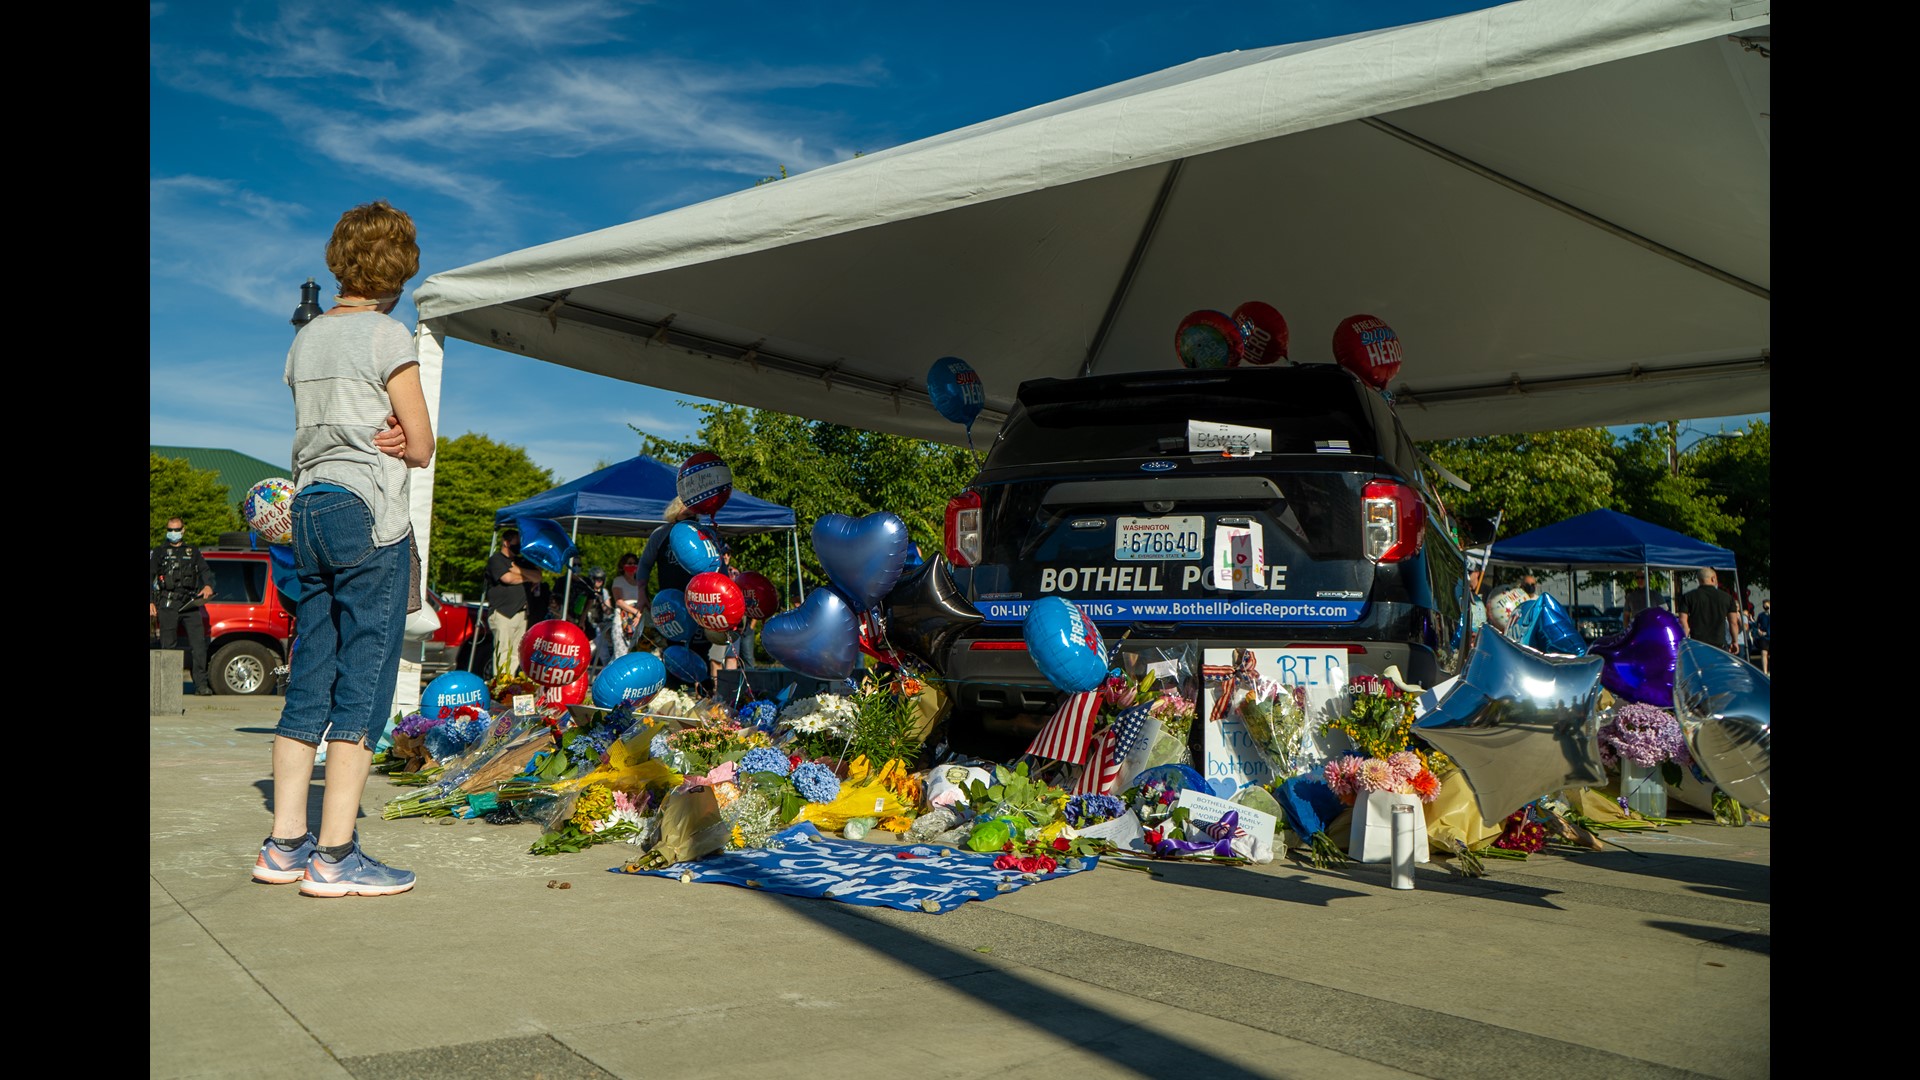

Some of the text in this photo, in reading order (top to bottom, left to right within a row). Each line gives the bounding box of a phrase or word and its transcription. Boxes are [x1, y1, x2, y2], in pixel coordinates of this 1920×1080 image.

[1366, 340, 1403, 367] HERO
[273, 500, 288, 516] So
[264, 513, 292, 542] SPECIA
[1122, 523, 1170, 531] WASHINGTON
[1131, 531, 1198, 553] 67664D
[1040, 566, 1164, 593] BOTHELL
[690, 613, 729, 629] HERO
[990, 604, 1031, 617] ON-LIN
[1132, 602, 1347, 618] www.BothellPoliceReports.com
[533, 637, 580, 657] #REALLIFE
[529, 663, 576, 685] HERO
[437, 689, 482, 706] #REALLIFE
[622, 677, 665, 700] #REALLIFE
[1221, 721, 1252, 749] Fro
[1207, 751, 1269, 777] bottom
[1196, 796, 1227, 809] BOTHELL
[1228, 805, 1252, 817] POLICE
